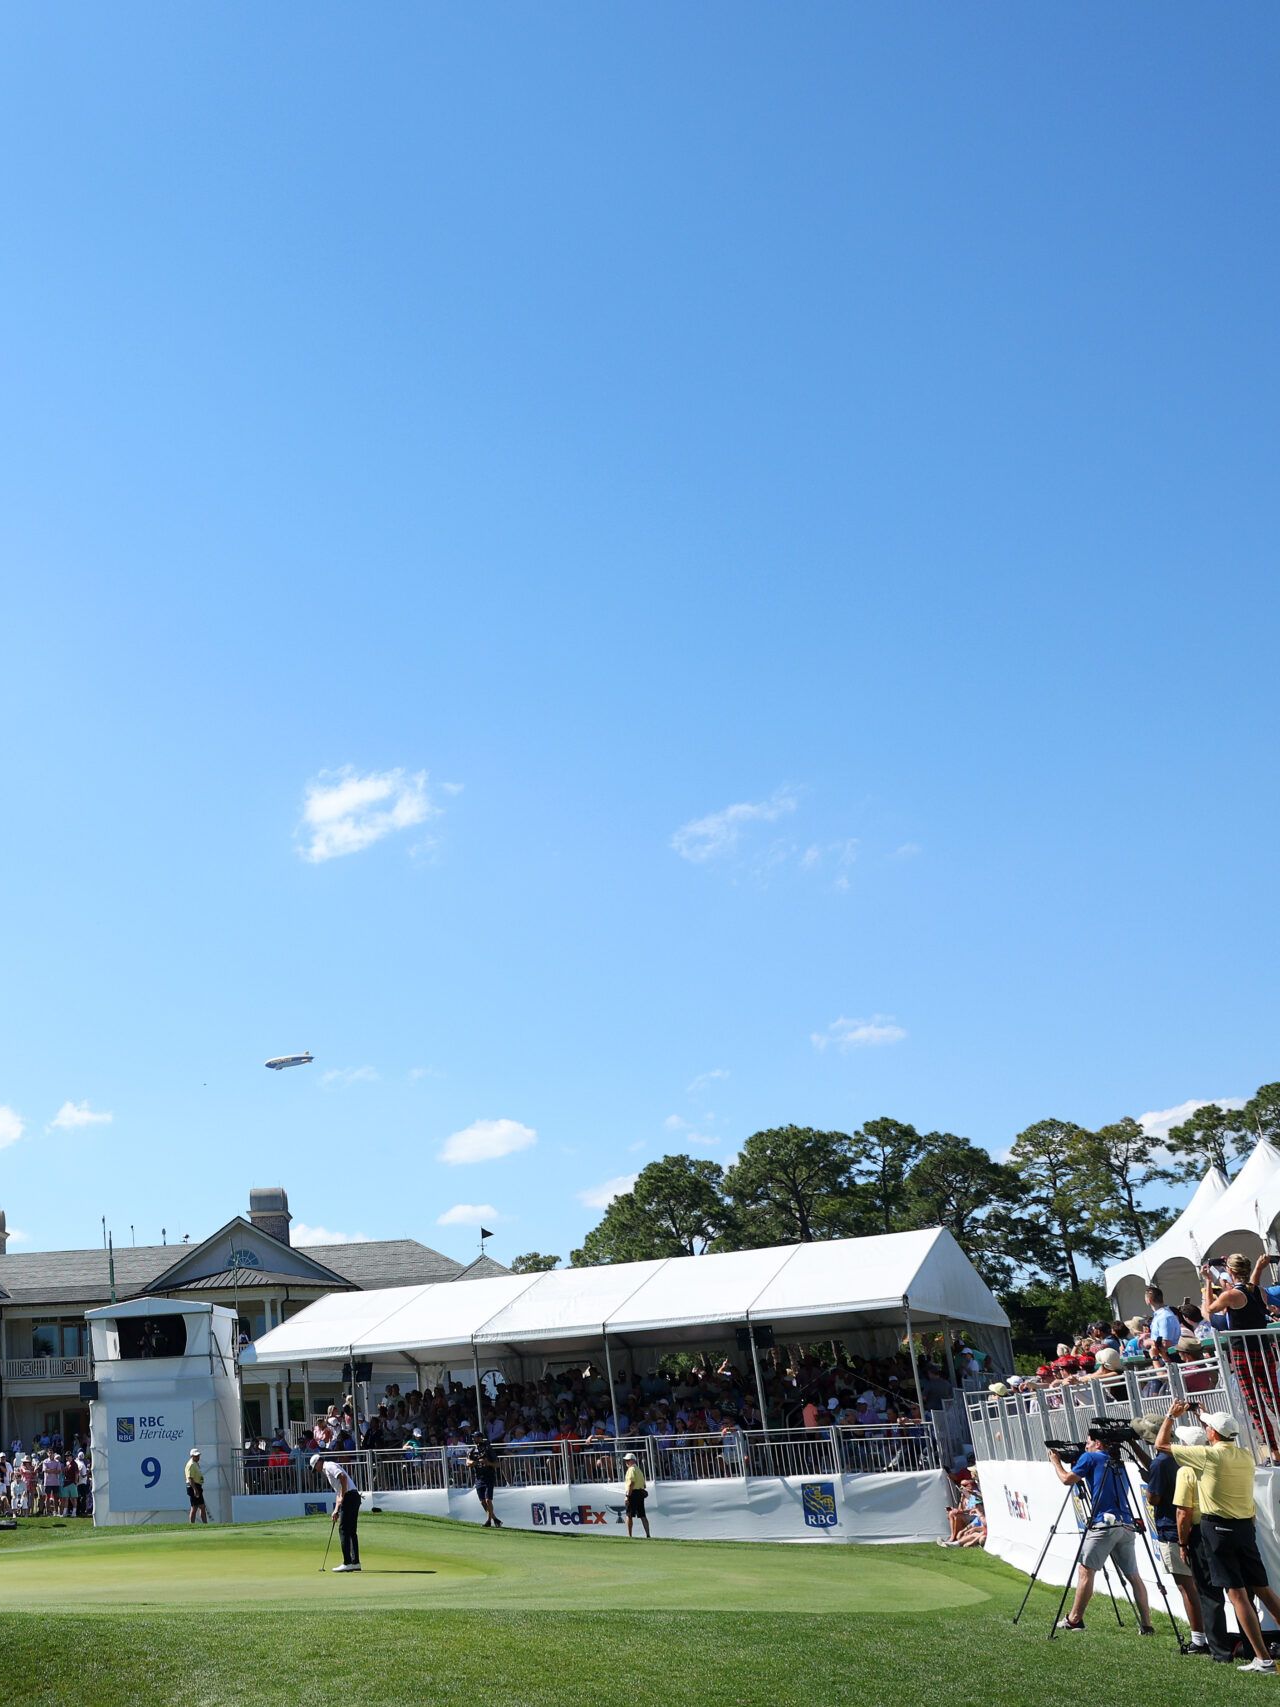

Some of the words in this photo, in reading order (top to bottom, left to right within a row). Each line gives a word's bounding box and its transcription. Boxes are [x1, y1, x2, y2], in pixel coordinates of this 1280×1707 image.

[139, 1416, 165, 1427] RBC
[139, 1428, 184, 1441] Heritage
[141, 1456, 161, 1489] 9
[550, 1505, 607, 1525] FedEx
[808, 1514, 835, 1525] RBC
